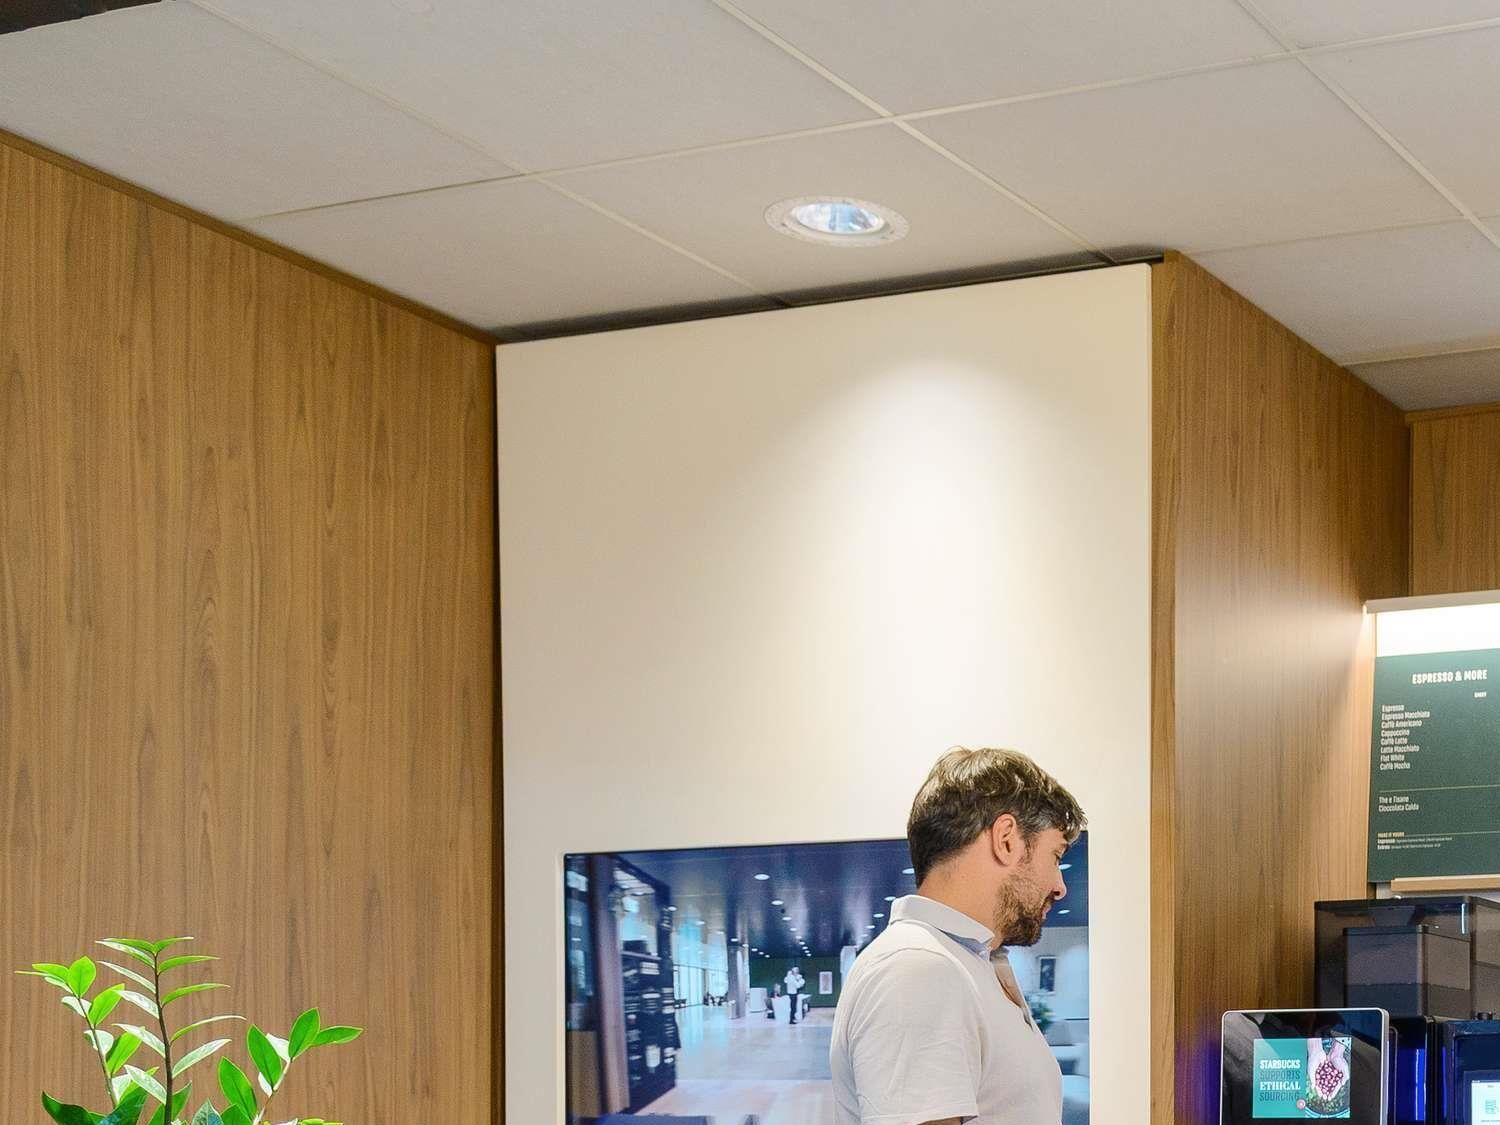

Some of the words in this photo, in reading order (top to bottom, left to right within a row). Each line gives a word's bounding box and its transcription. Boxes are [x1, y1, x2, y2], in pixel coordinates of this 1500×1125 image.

[1412, 672, 1454, 685] ESPRESSO
[1455, 671, 1463, 682] &
[1464, 669, 1488, 681] MORE
[1259, 1059, 1301, 1070] STARBUCKS
[1259, 1070, 1301, 1080] SUPPORTS
[1259, 1081, 1301, 1091] ETHICAL
[1259, 1091, 1300, 1101] SOURCING
